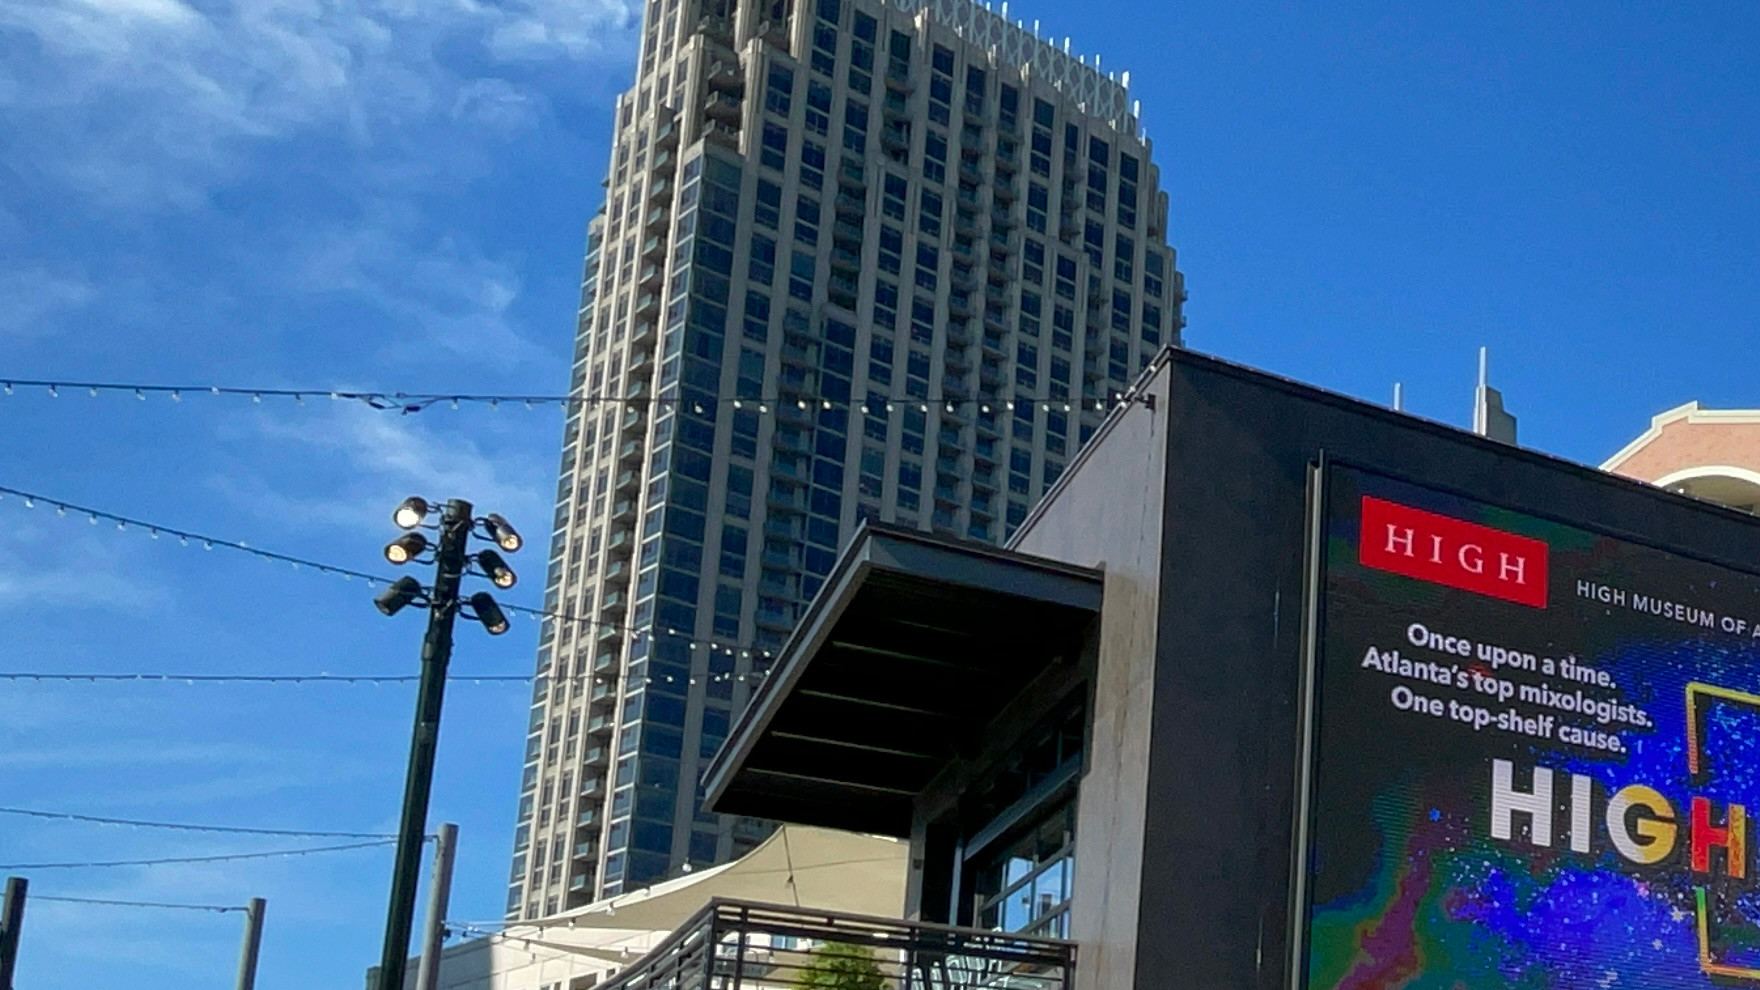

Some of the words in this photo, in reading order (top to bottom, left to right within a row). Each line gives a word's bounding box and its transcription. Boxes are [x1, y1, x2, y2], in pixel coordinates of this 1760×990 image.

[1385, 523, 1526, 585] HIGH
[1576, 579, 1627, 608] HIGH
[1632, 593, 1715, 629] MUSEUM
[1721, 615, 1747, 635] OF
[1362, 645, 1470, 689] Atlanta's
[1473, 667, 1514, 702] top
[1519, 679, 1654, 728] mixologists.
[1407, 623, 1471, 657] Once
[1477, 640, 1536, 677] upon
[1541, 656, 1556, 676] a
[1558, 653, 1617, 689] time.
[1390, 687, 1444, 718] One
[1448, 698, 1554, 741] top-shelf
[1558, 723, 1628, 755] cause.
